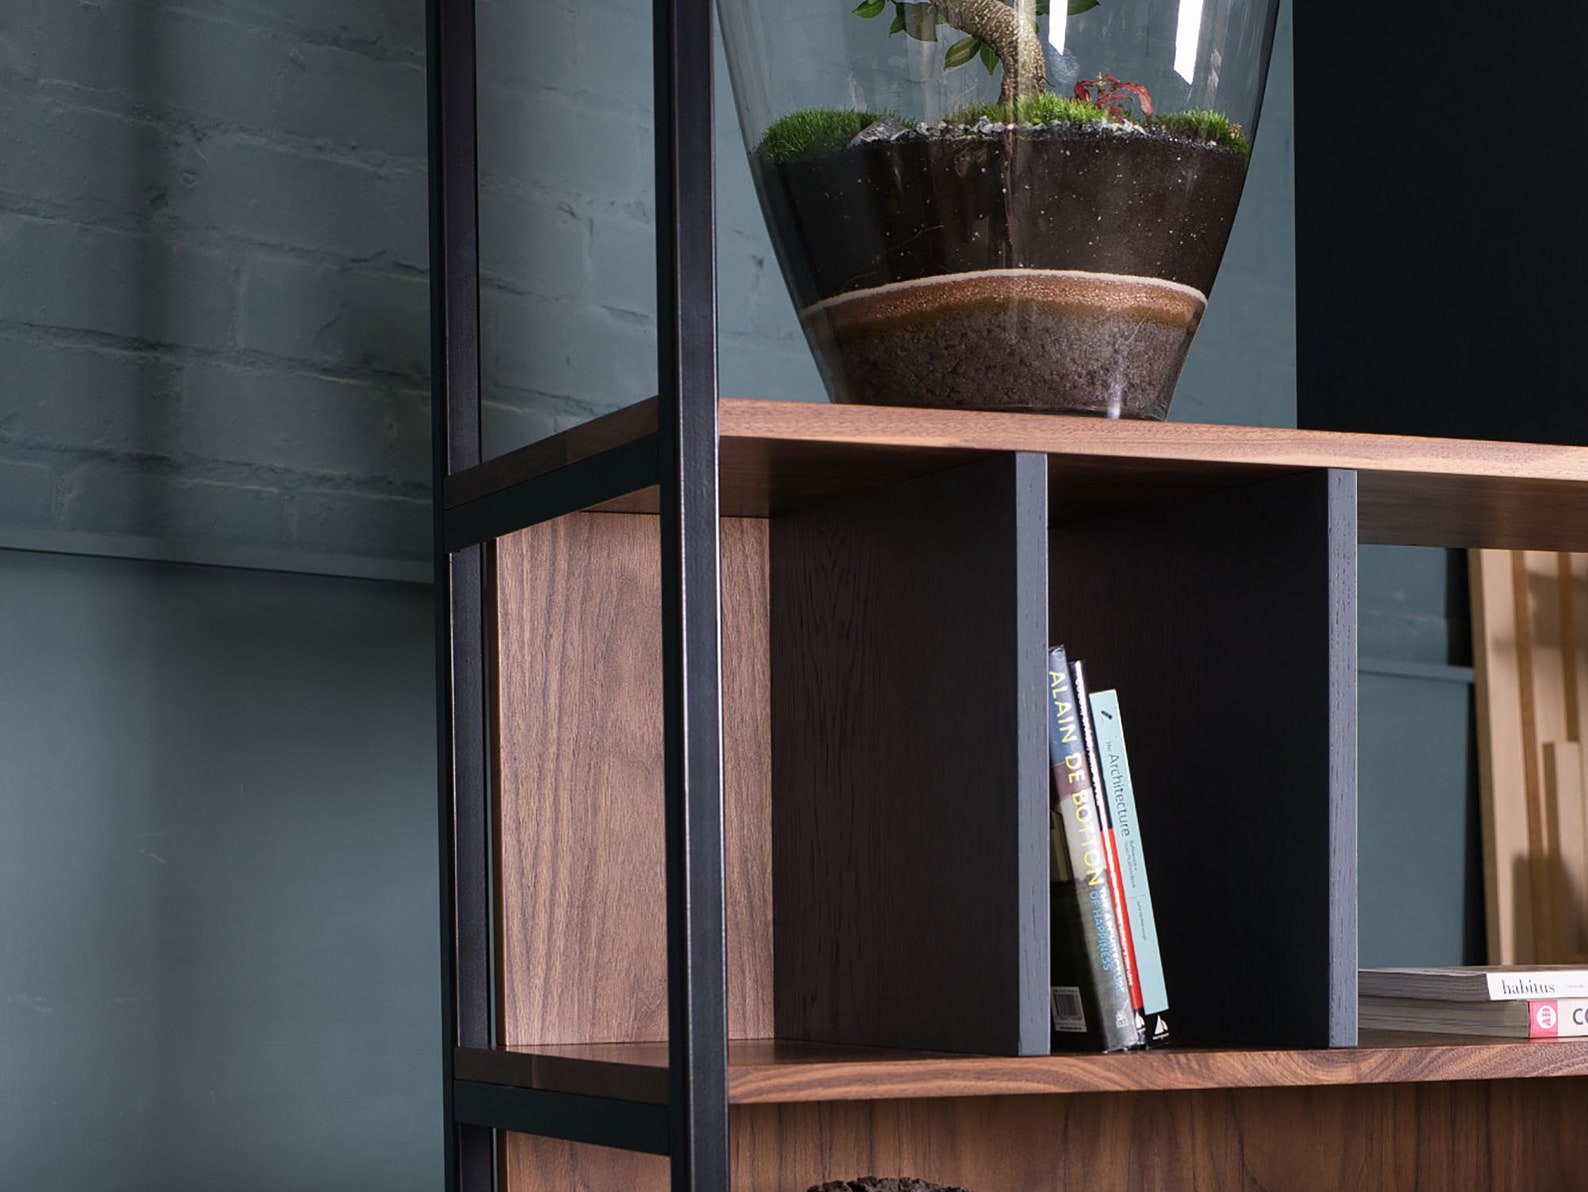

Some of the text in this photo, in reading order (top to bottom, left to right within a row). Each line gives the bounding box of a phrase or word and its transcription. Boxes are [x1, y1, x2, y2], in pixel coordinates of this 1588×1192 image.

[1049, 671, 1078, 743] ALAIN
[1065, 752, 1085, 784] DE
[1108, 753, 1130, 837] Architecture
[1072, 789, 1104, 886] BOTTON
[1089, 890, 1112, 971] OF HAPPINESS
[1501, 979, 1556, 995] habitus
[1572, 1008, 1588, 1026] C
